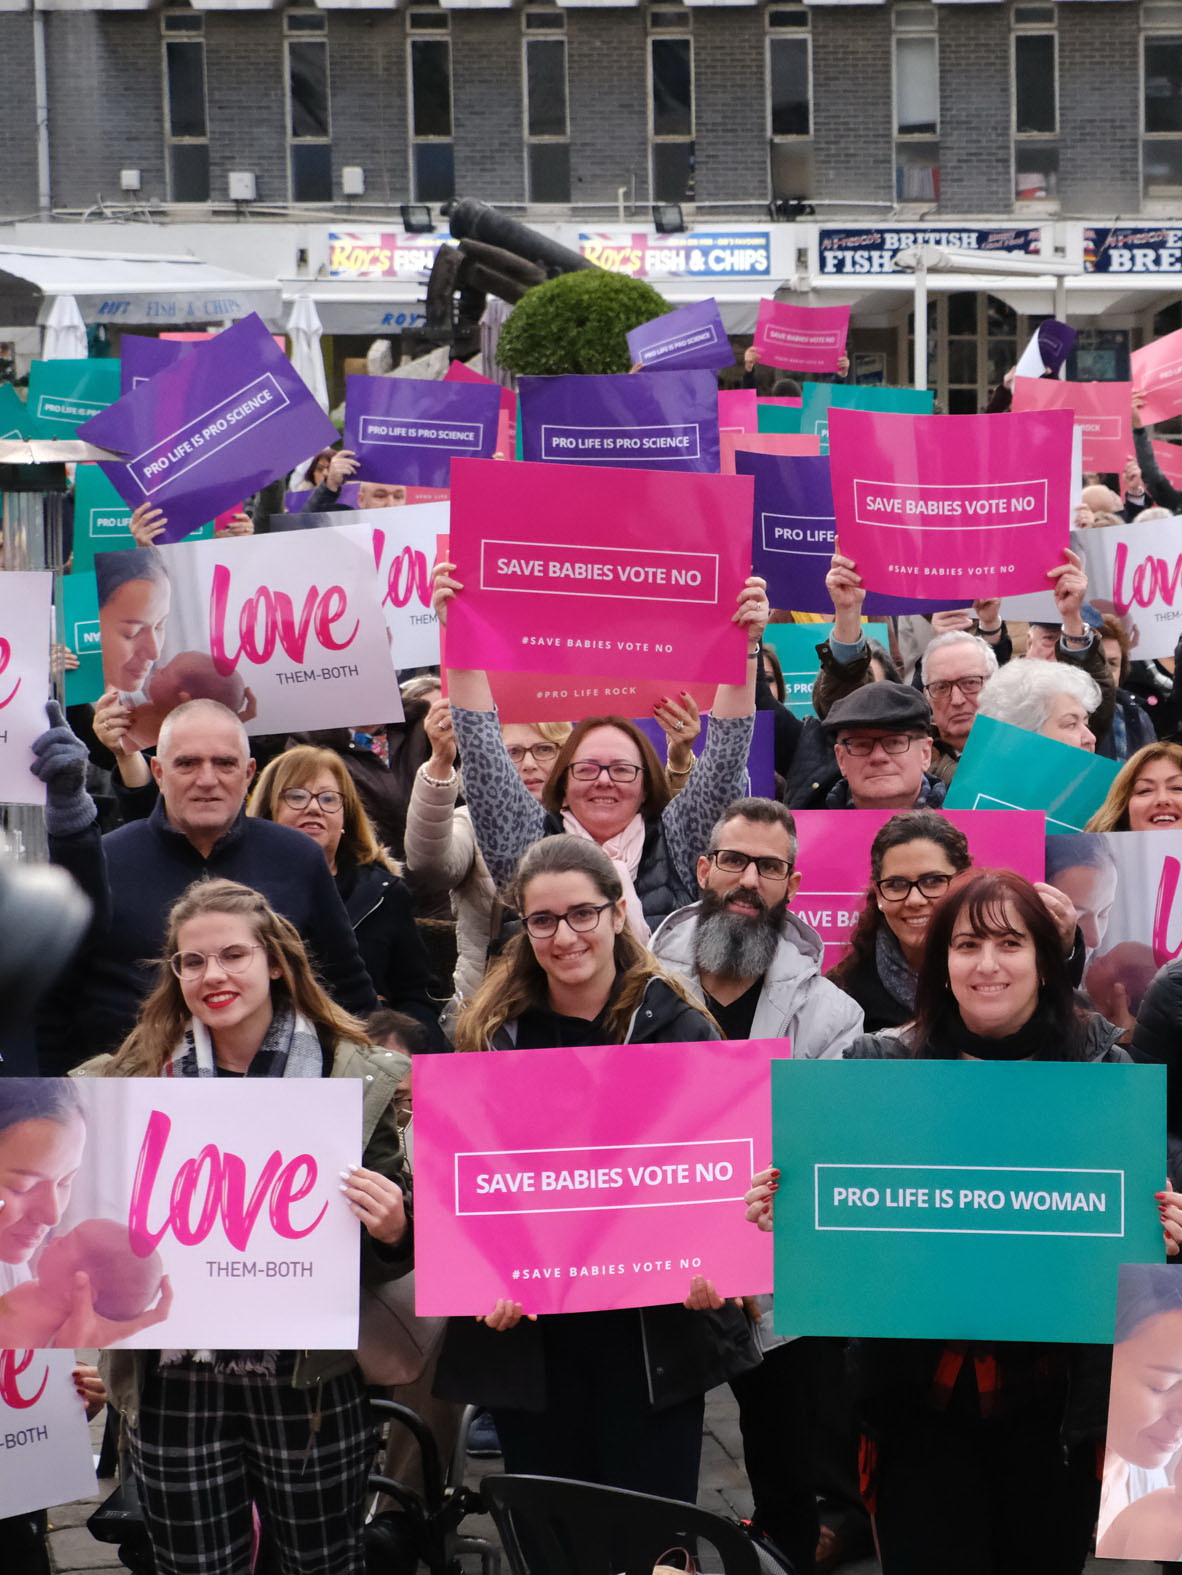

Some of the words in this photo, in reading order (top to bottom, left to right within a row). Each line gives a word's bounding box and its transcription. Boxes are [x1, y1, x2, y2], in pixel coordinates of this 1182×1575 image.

[884, 232, 979, 249] BRITISH
[394, 249, 434, 271] FISH
[645, 249, 686, 271] FISH
[689, 249, 705, 271] &
[708, 249, 767, 272] CHIPS
[824, 251, 893, 272] FISH
[382, 313, 421, 325] ROY
[143, 454, 168, 480] PRO
[167, 439, 193, 465] LIFE
[191, 434, 205, 450] IS
[203, 418, 228, 442] PRO
[227, 390, 273, 425] SCIENCE
[368, 425, 388, 436] PRO
[389, 426, 406, 437] LIFE
[408, 427, 416, 437] IS
[418, 428, 437, 439] PRO
[438, 429, 475, 441] SCIENCE
[552, 437, 576, 449] PRO
[578, 437, 602, 449] LIFE
[604, 437, 614, 449] IS
[616, 437, 641, 449] PRO
[642, 436, 690, 449] SCIENCE
[866, 496, 903, 512] SAVE
[906, 498, 962, 516] BABIES
[965, 498, 1009, 515] VOTE
[1012, 496, 1035, 511] NO
[97, 518, 116, 527] PRO
[117, 518, 132, 527] LIF
[775, 527, 803, 542] PRO
[807, 529, 835, 543] LIFE
[497, 558, 544, 578] SAVE
[548, 561, 614, 581] BABIES
[617, 565, 667, 584] VOTE
[671, 568, 702, 586] NO
[888, 565, 920, 575] #SAVE
[924, 566, 963, 576] BABIES
[968, 566, 996, 576] VOTE
[1000, 565, 1015, 574] NO
[210, 564, 360, 677] love
[521, 636, 561, 648] #SAVE
[567, 638, 614, 650] BABIES
[617, 641, 650, 652] VOTE
[655, 642, 674, 654] NO
[276, 665, 359, 686] THEM-BOTH
[536, 688, 570, 699] #PRO
[574, 687, 600, 698] LIFE
[604, 686, 637, 697] ROCK
[797, 911, 832, 927] AVE
[129, 1110, 329, 1258] love
[476, 1172, 535, 1194] SAVE
[541, 1168, 623, 1191] BABIES
[627, 1165, 689, 1187] VOTE
[695, 1161, 734, 1183] NO
[833, 1187, 880, 1207] PRO
[885, 1188, 929, 1208] LIFE
[935, 1189, 954, 1208] IS
[959, 1190, 1006, 1210] PRO
[1010, 1190, 1106, 1212] WOMAN
[206, 1261, 313, 1278] THEM-BOTH
[511, 1268, 562, 1280] #SAVE
[569, 1264, 626, 1278] BABIES
[632, 1260, 673, 1273] VOTE
[680, 1257, 702, 1270] NO
[0, 1425, 48, 1450] -BOTH
